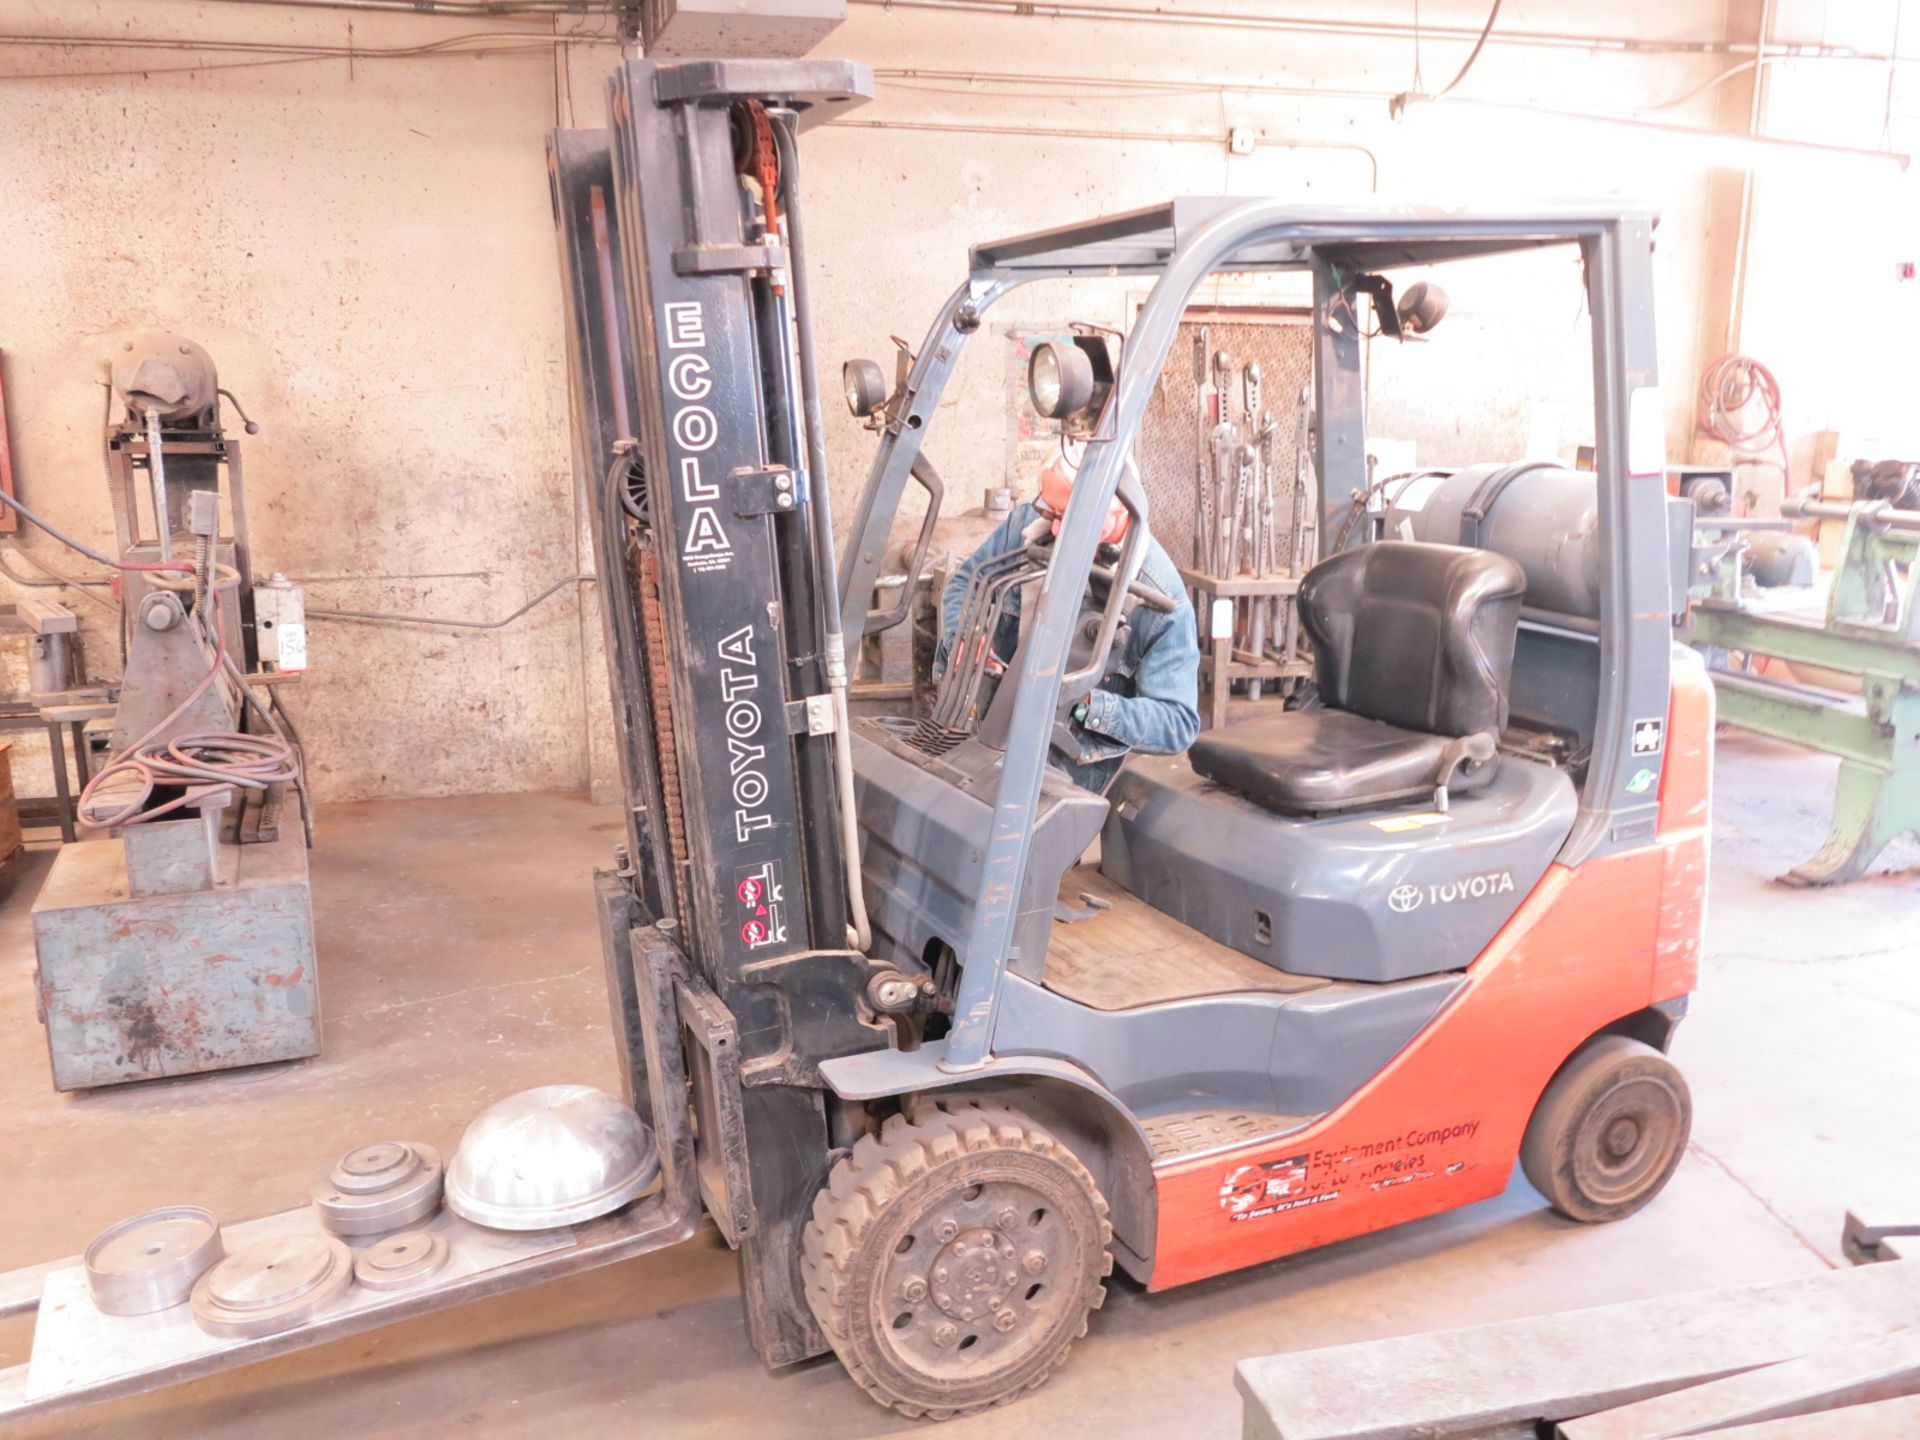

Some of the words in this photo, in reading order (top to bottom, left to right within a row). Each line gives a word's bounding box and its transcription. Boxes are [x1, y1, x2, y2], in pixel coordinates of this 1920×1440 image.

[664, 302, 730, 552] ECOLA
[718, 625, 769, 842] TOYOTA
[1429, 871, 1514, 904] TOYOTA
[1313, 1136, 1402, 1169] Eqment
[1406, 1120, 1480, 1149] Company
